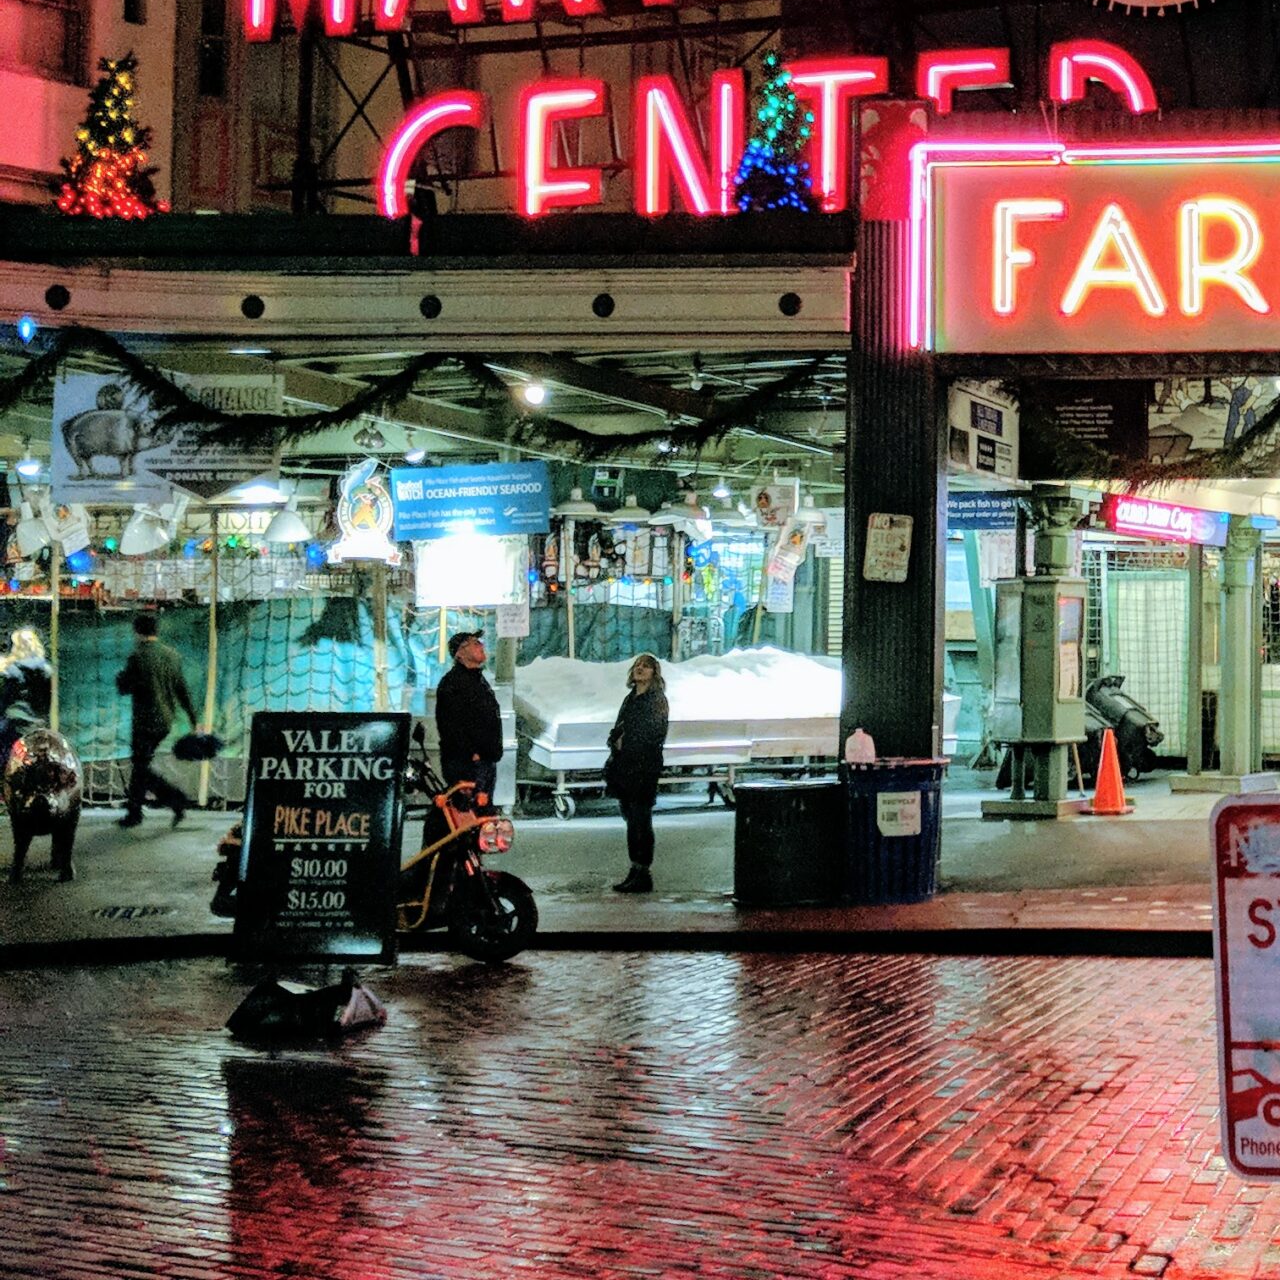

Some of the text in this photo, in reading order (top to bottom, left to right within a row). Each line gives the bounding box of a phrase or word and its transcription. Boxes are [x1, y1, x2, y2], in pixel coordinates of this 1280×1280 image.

[426, 482, 542, 500] OCEAN-FRIENDLY SEAFOOD
[281, 729, 374, 754] VALET
[258, 756, 395, 781] PARKING
[303, 781, 347, 799] FOR
[273, 804, 371, 837] PIKE PLACE
[290, 858, 348, 879] $10.00
[287, 891, 346, 910] $15.00
